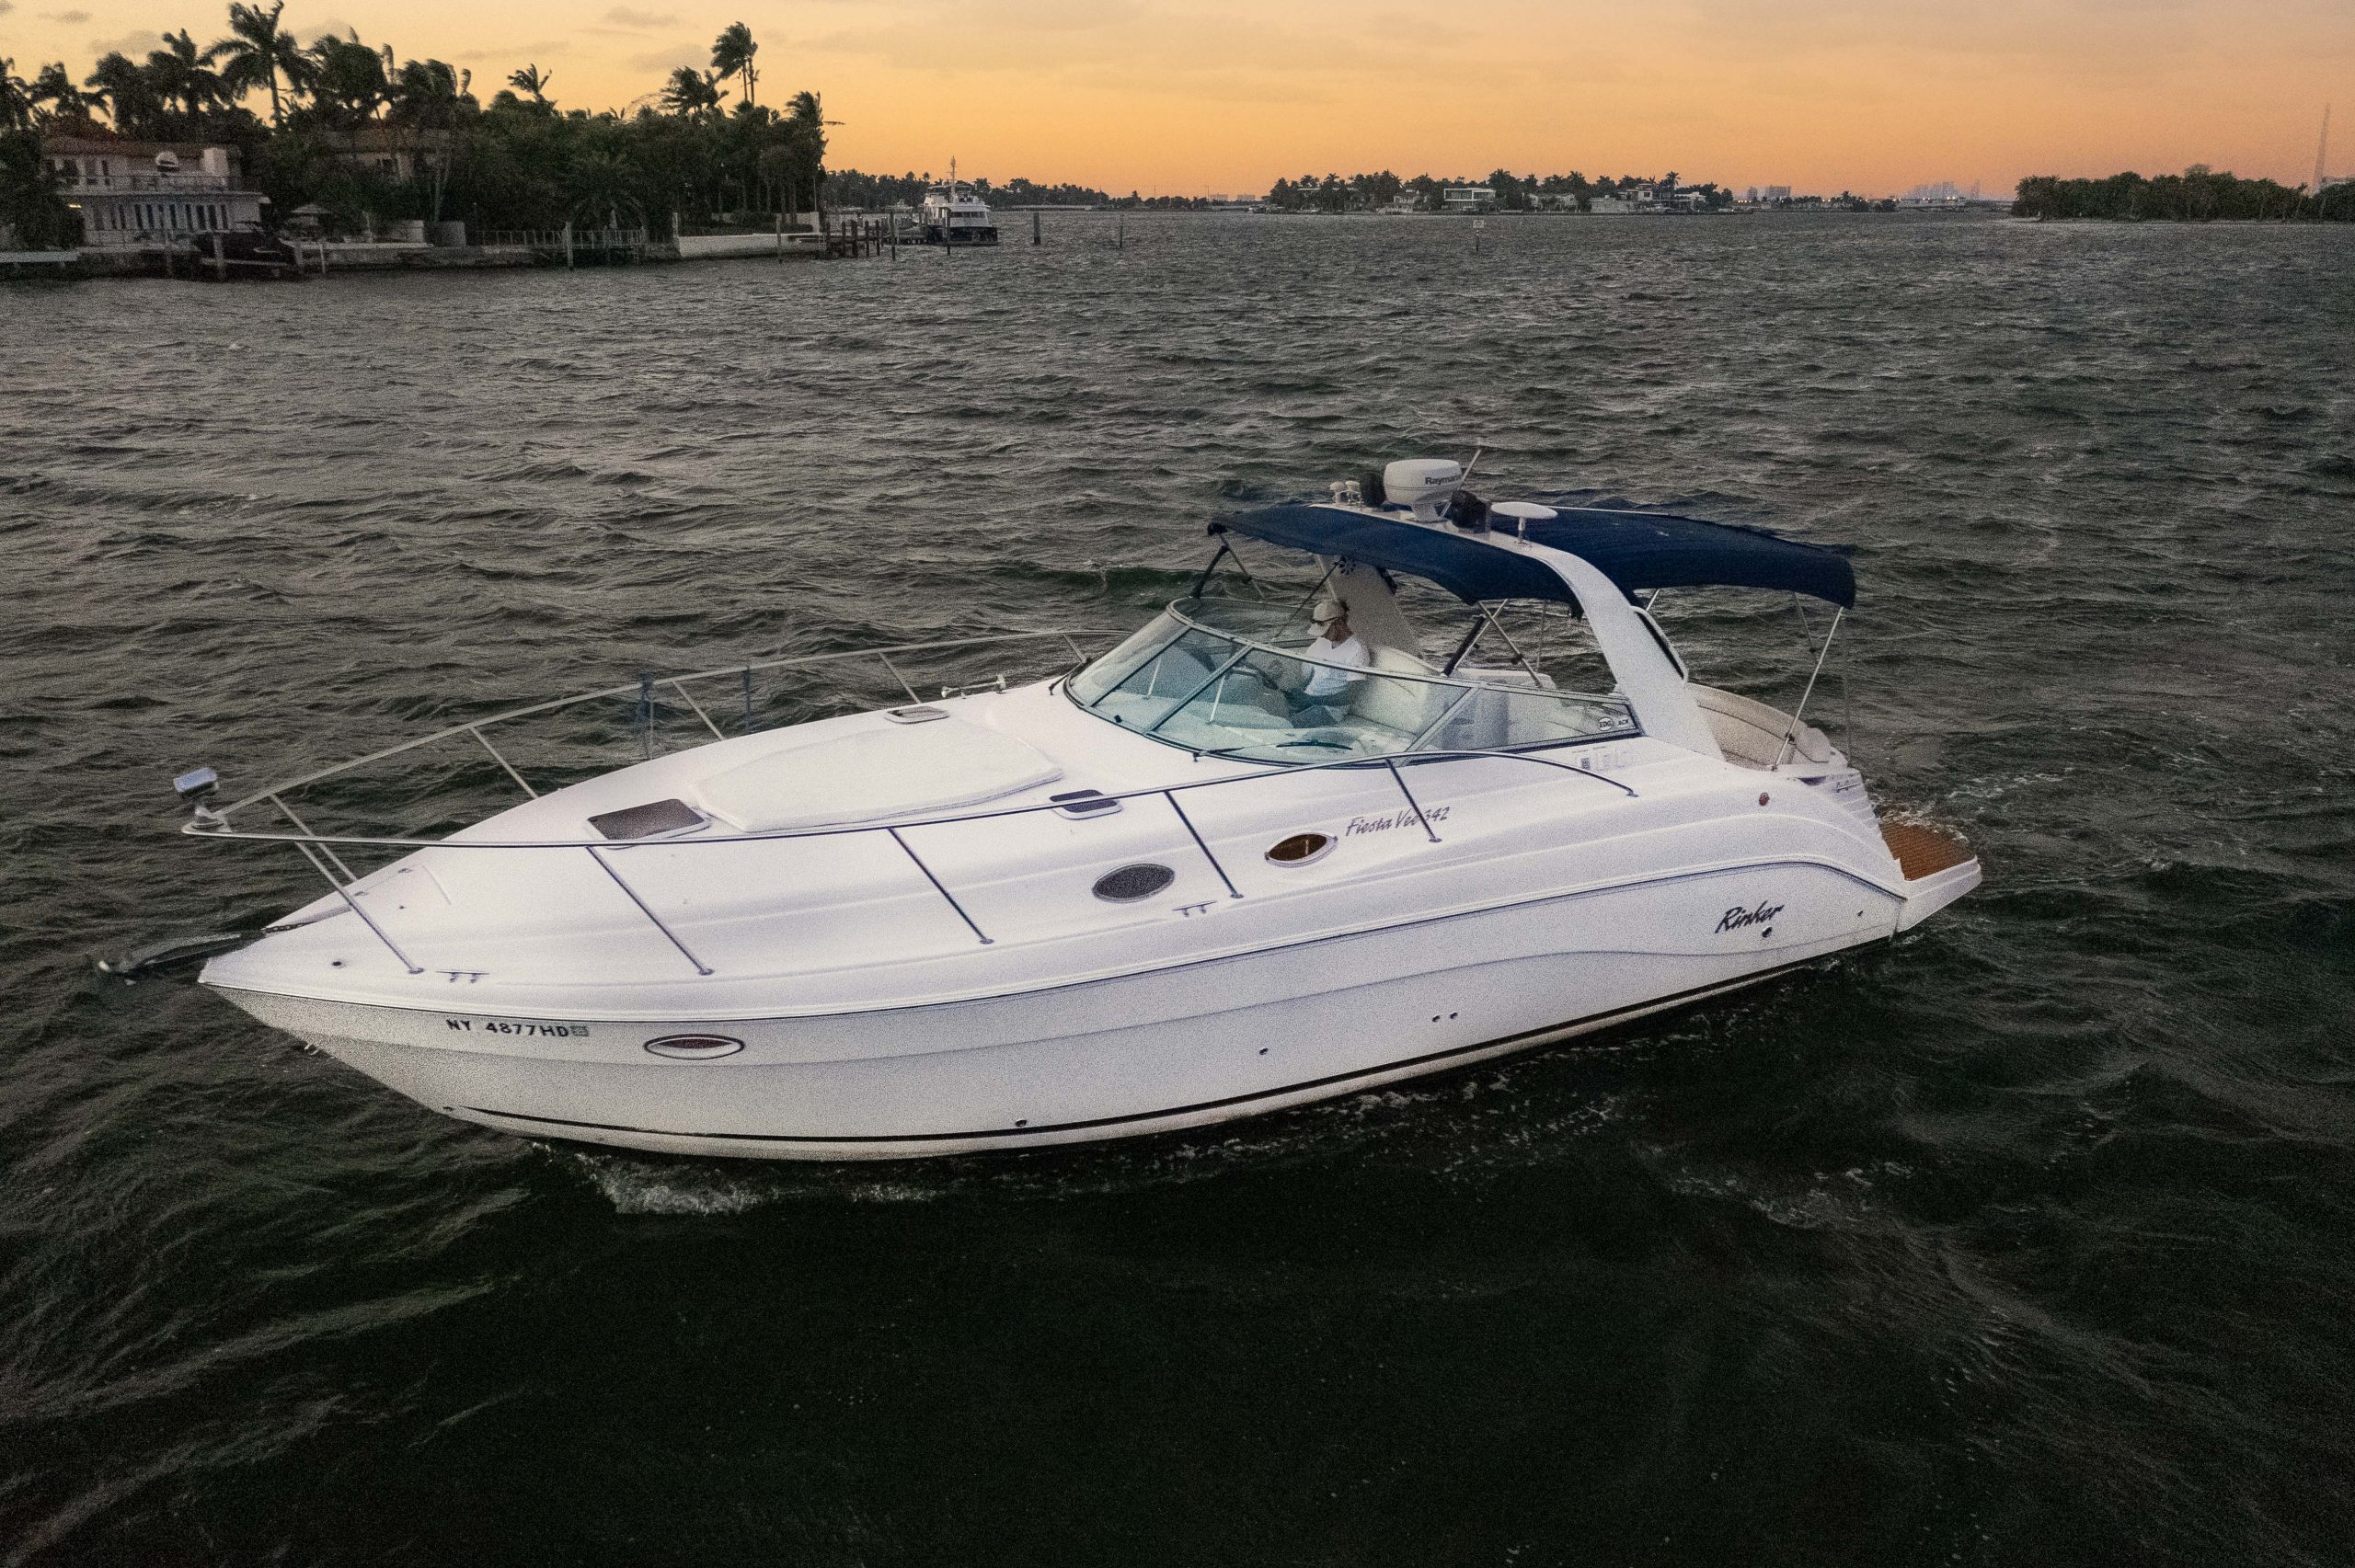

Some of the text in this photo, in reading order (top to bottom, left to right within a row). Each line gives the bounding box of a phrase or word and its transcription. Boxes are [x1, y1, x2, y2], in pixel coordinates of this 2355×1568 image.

[1346, 807, 1451, 836] Fiesta Vee 342
[1715, 900, 1785, 933] Rinker
[446, 1019, 471, 1031] NY
[486, 1023, 569, 1037] 4877HD
